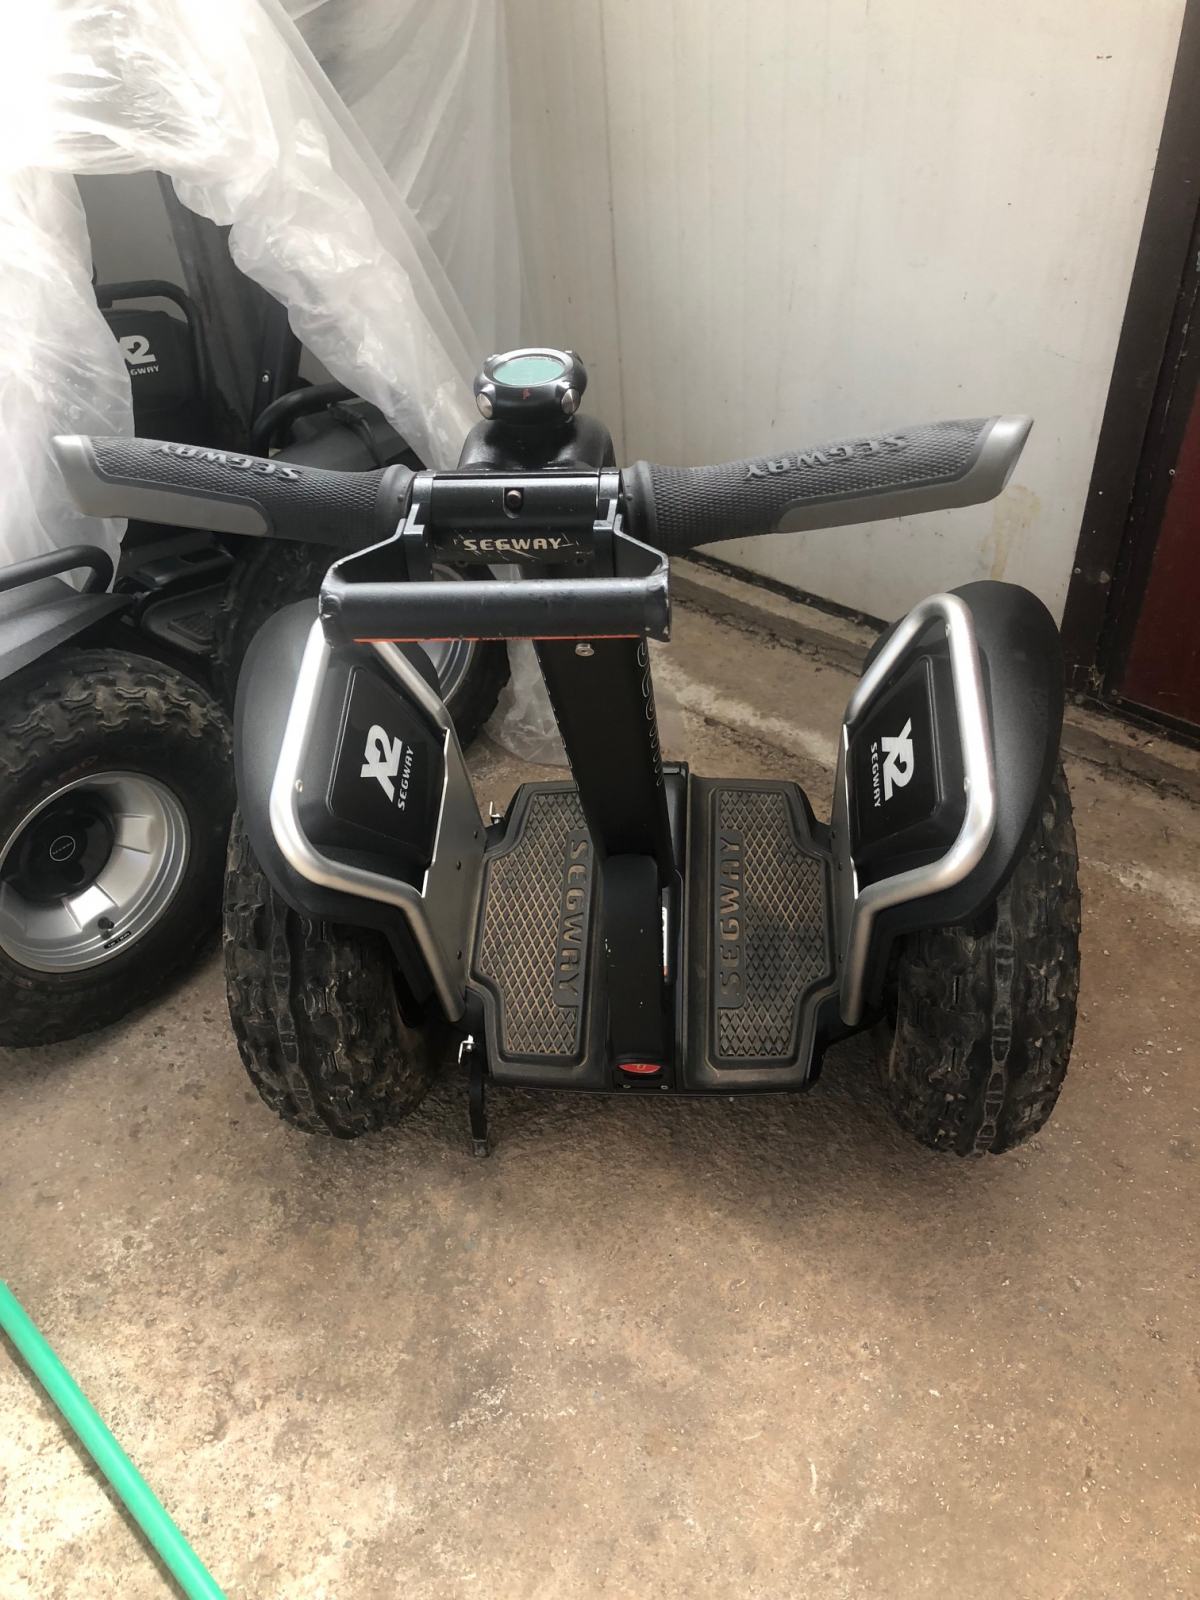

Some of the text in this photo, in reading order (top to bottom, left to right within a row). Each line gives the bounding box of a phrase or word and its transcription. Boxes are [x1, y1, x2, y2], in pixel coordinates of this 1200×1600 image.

[157, 443, 303, 479] SEGWAY
[744, 436, 906, 480] SEGWAY
[463, 538, 561, 551] SEGWAY
[360, 724, 402, 803] X2
[397, 746, 414, 812] SEGWAY
[871, 741, 881, 808] SEGWAY
[881, 717, 914, 801] X2
[558, 839, 589, 996] SEGWAY
[720, 837, 742, 997] SEGWAY
